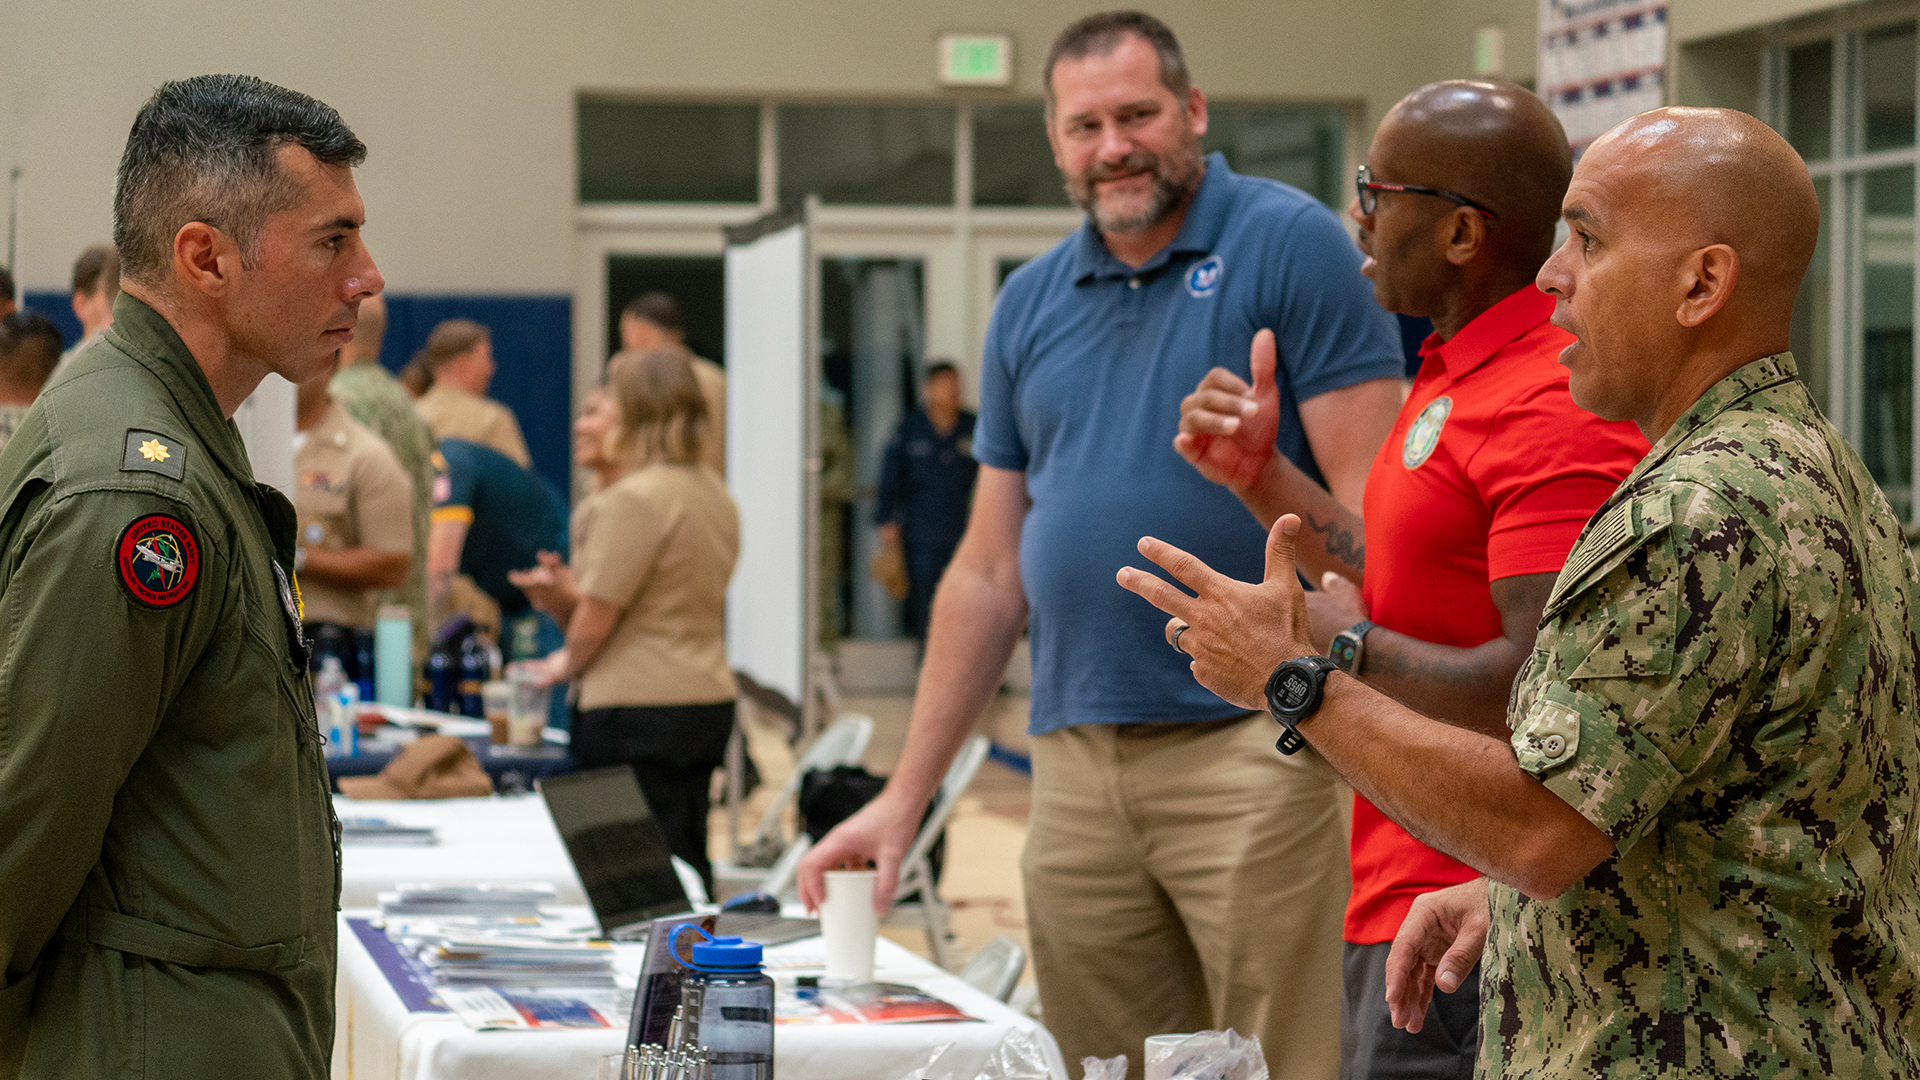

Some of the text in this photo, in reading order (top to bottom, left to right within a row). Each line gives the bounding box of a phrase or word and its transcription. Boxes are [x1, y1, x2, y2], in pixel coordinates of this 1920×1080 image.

[130, 520, 196, 565] UNITED STATES NAVY
[157, 580, 189, 600] INSTRUCTOR
[1287, 678, 1307, 697] 0955
